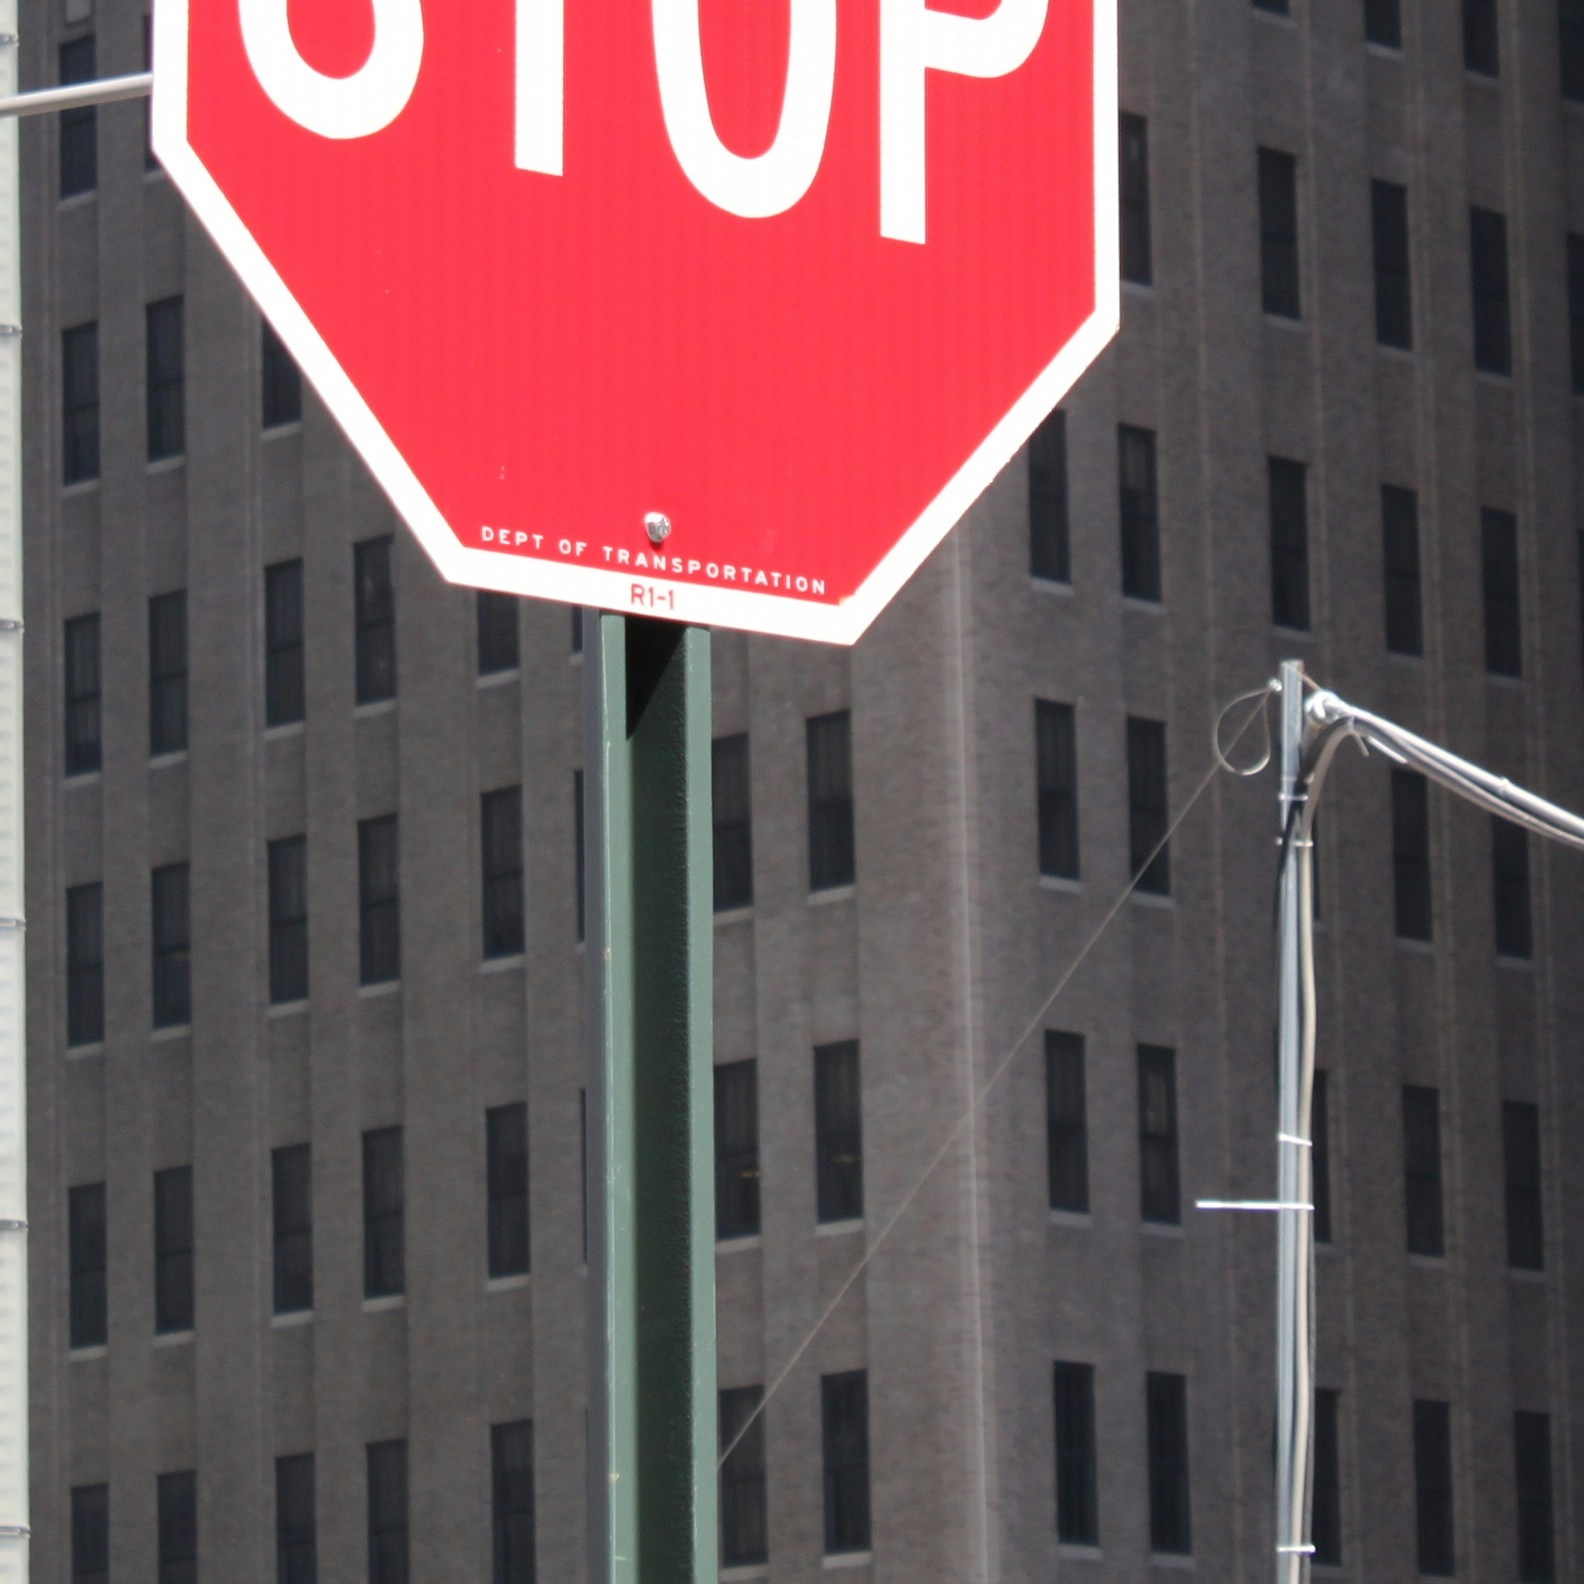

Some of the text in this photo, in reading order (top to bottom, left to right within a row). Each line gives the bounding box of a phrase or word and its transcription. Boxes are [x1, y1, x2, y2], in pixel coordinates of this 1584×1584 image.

[480, 526, 826, 595] DEPT OF TRANSPORTATION
[629, 583, 675, 611] R1-1
